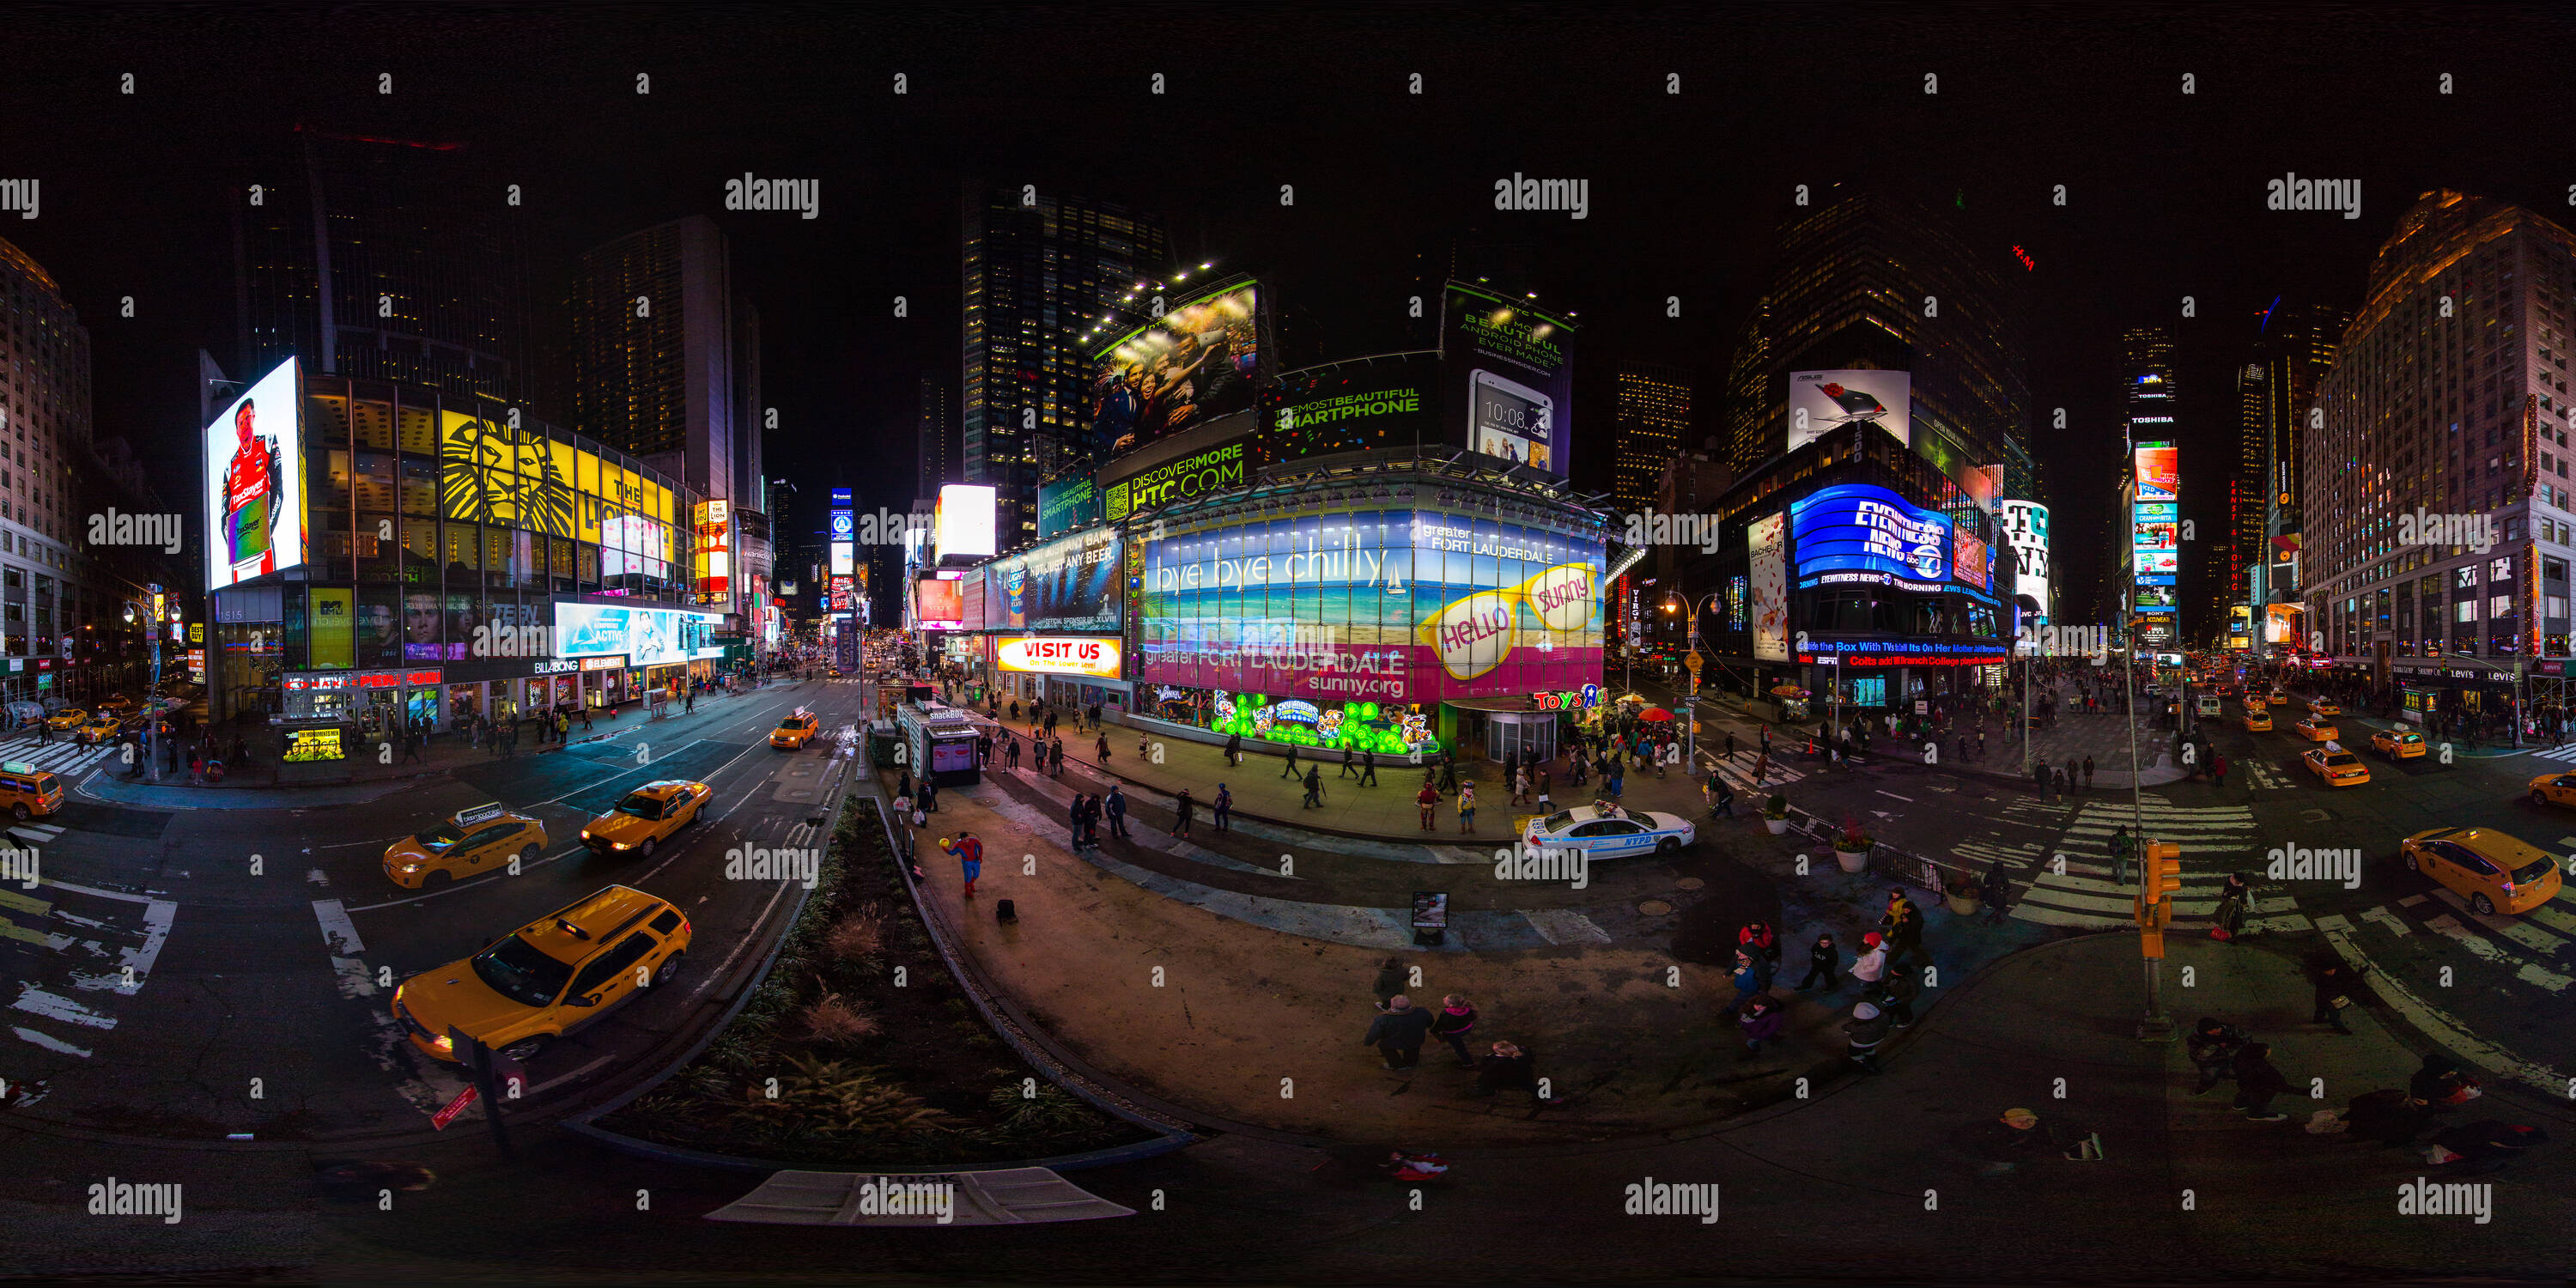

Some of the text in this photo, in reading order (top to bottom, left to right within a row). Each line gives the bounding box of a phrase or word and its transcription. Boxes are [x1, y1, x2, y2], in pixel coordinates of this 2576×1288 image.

[1505, 304, 1530, 316] htc
[1465, 313, 1562, 355] BEAUTIFUL
[1460, 323, 1564, 365] ANDROID PHONE
[1479, 337, 1512, 355] EVER
[1274, 398, 1419, 433] SMARTPHONE
[1485, 400, 1526, 429] 10:08
[1934, 419, 1946, 433] OPEN
[232, 477, 264, 505] TaxSlayer
[614, 479, 641, 502] THE
[2142, 483, 2155, 493] ICED
[1042, 488, 1093, 520] SMARTPHONE
[236, 518, 260, 535] TaxSlayer
[1855, 501, 1945, 546] EYEWITNESS
[1422, 525, 1471, 540] greater
[1066, 536, 1084, 551] ANY
[1431, 538, 1553, 565] FORT LAUDERDALE
[1863, 529, 1905, 562] NEWS
[1010, 562, 1024, 573] BUD
[1030, 566, 1043, 578] NOT
[1044, 560, 1065, 575] JUST
[1066, 553, 1084, 568] ANY
[1157, 533, 1388, 597] bye bye chilly
[1905, 553, 1920, 565] abc
[1008, 570, 1026, 583] LIGHT
[1821, 574, 1858, 584] EYEWITNESS
[1859, 574, 1880, 583] NEWS
[1904, 583, 1941, 592] MORNING
[221, 611, 242, 620] 1515
[493, 603, 539, 625] TEEN
[596, 630, 623, 642] ACTIVE
[1024, 642, 1100, 659] VISIT US
[1820, 641, 1834, 652] the
[1836, 641, 1856, 652] Box
[1859, 641, 1880, 652] With
[1882, 641, 1895, 652] TVs
[1909, 642, 1921, 653] Its
[1923, 643, 1933, 653] On
[1935, 643, 1951, 653] Her
[1953, 643, 1973, 653] Mother
[535, 660, 578, 674] BILLABONG
[593, 658, 621, 668] ELEMENT
[1081, 660, 1096, 669] Level
[1145, 648, 1405, 676] greater FORT LAUDERDALE
[1849, 655, 1876, 666] Colts
[1878, 655, 1893, 666] add
[1901, 656, 1929, 666] Branch
[1929, 656, 1959, 667] College
[1309, 675, 1404, 698] sunny.org
[929, 709, 964, 720] snackBOX
[1277, 700, 1319, 719] SKYLANDERS
[1624, 835, 1652, 846] NYPD
